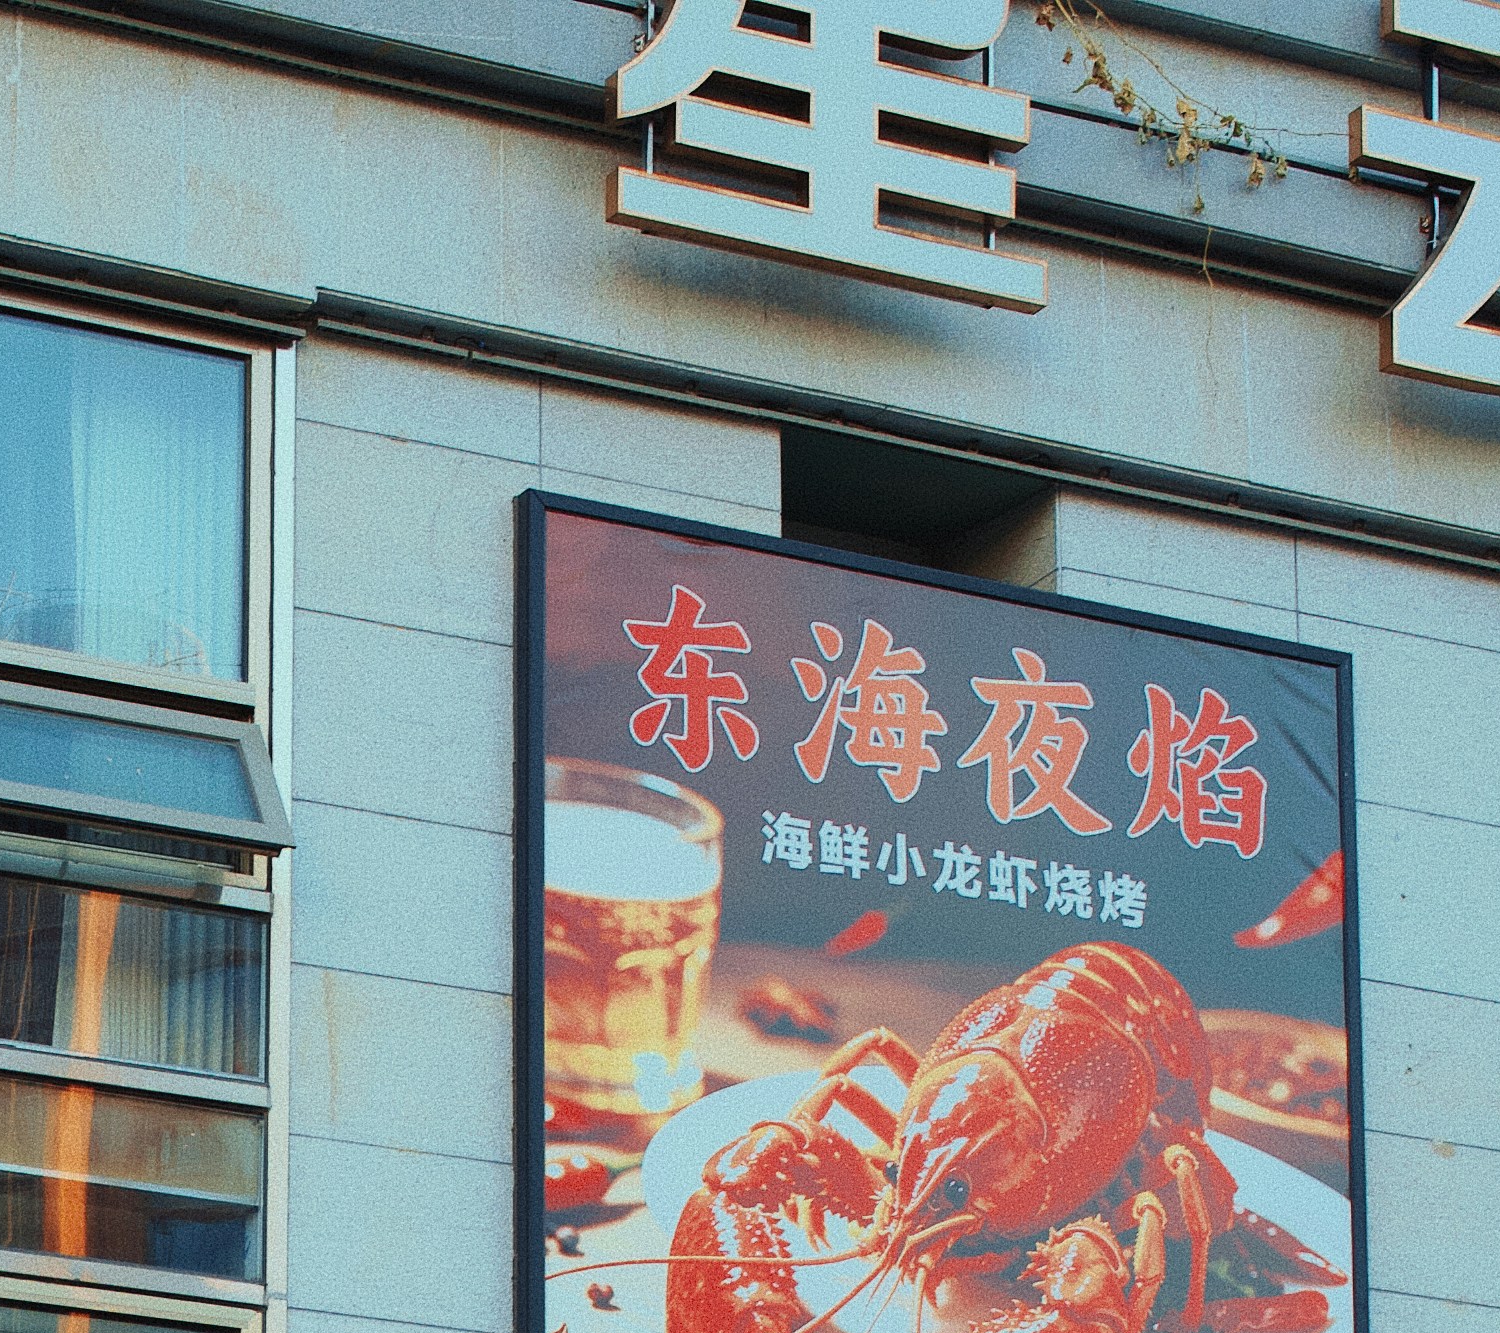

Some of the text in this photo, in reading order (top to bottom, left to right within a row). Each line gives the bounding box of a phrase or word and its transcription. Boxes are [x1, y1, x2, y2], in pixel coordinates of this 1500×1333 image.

[622, 584, 1266, 860] 东海夜焰
[761, 809, 1148, 929] 海鲜小龙虾烧烤
